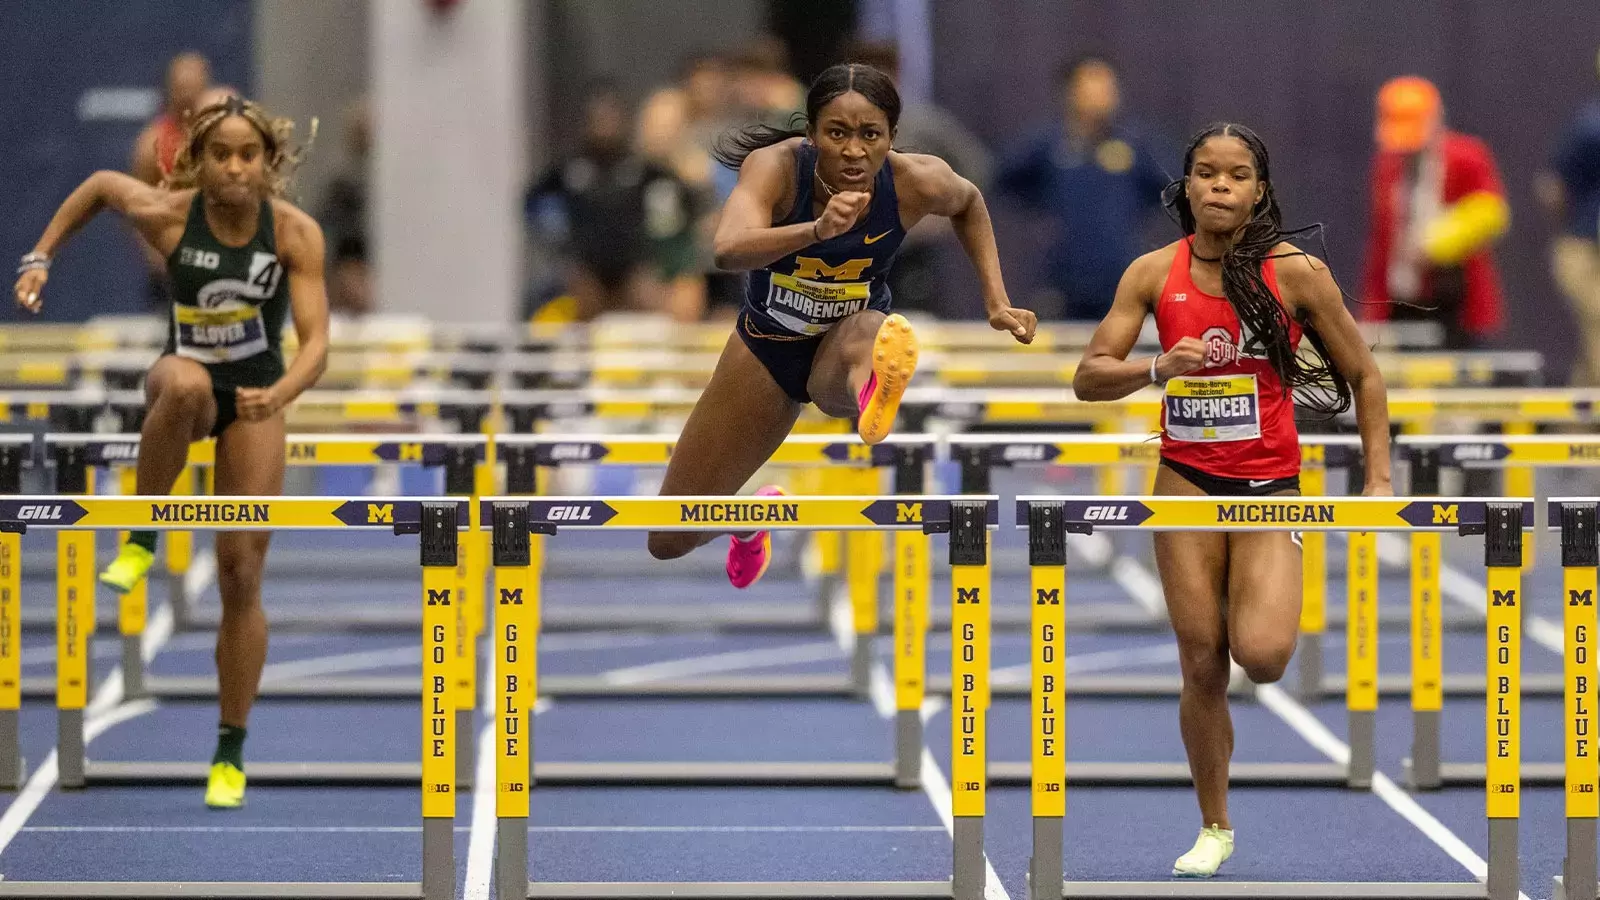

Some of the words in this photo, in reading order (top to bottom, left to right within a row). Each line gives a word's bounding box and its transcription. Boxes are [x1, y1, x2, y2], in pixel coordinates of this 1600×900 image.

[252, 260, 281, 294] 4
[790, 256, 874, 281] M
[774, 286, 862, 319] LAURENCIN
[1172, 399, 1180, 417] J
[1182, 396, 1251, 419] SPENCER
[17, 505, 62, 520] GILL
[151, 504, 270, 522] MICHIGAN
[367, 504, 394, 523] M
[547, 506, 592, 521] GILL
[680, 504, 799, 522] MICHIGAN
[896, 503, 923, 522] M
[1083, 506, 1129, 521] GILL
[1216, 504, 1335, 523] MICHIGAN
[1432, 504, 1458, 524] M
[428, 589, 451, 605] M
[500, 588, 523, 605] M
[957, 588, 980, 604] M
[1036, 588, 1060, 605] M
[1493, 589, 1516, 606] M
[1569, 589, 1593, 606] M
[433, 625, 445, 664] GO
[506, 624, 517, 663] GO
[962, 623, 974, 662] GO
[1042, 624, 1054, 663] GO
[1498, 625, 1510, 664] GO
[1575, 625, 1587, 664] GO
[432, 676, 446, 757] BLUE
[505, 675, 519, 756] BLUE
[961, 674, 975, 755] BLUE
[1041, 675, 1055, 756] BLUE
[1496, 676, 1510, 758] BLUE
[1575, 676, 1589, 758] BLUE
